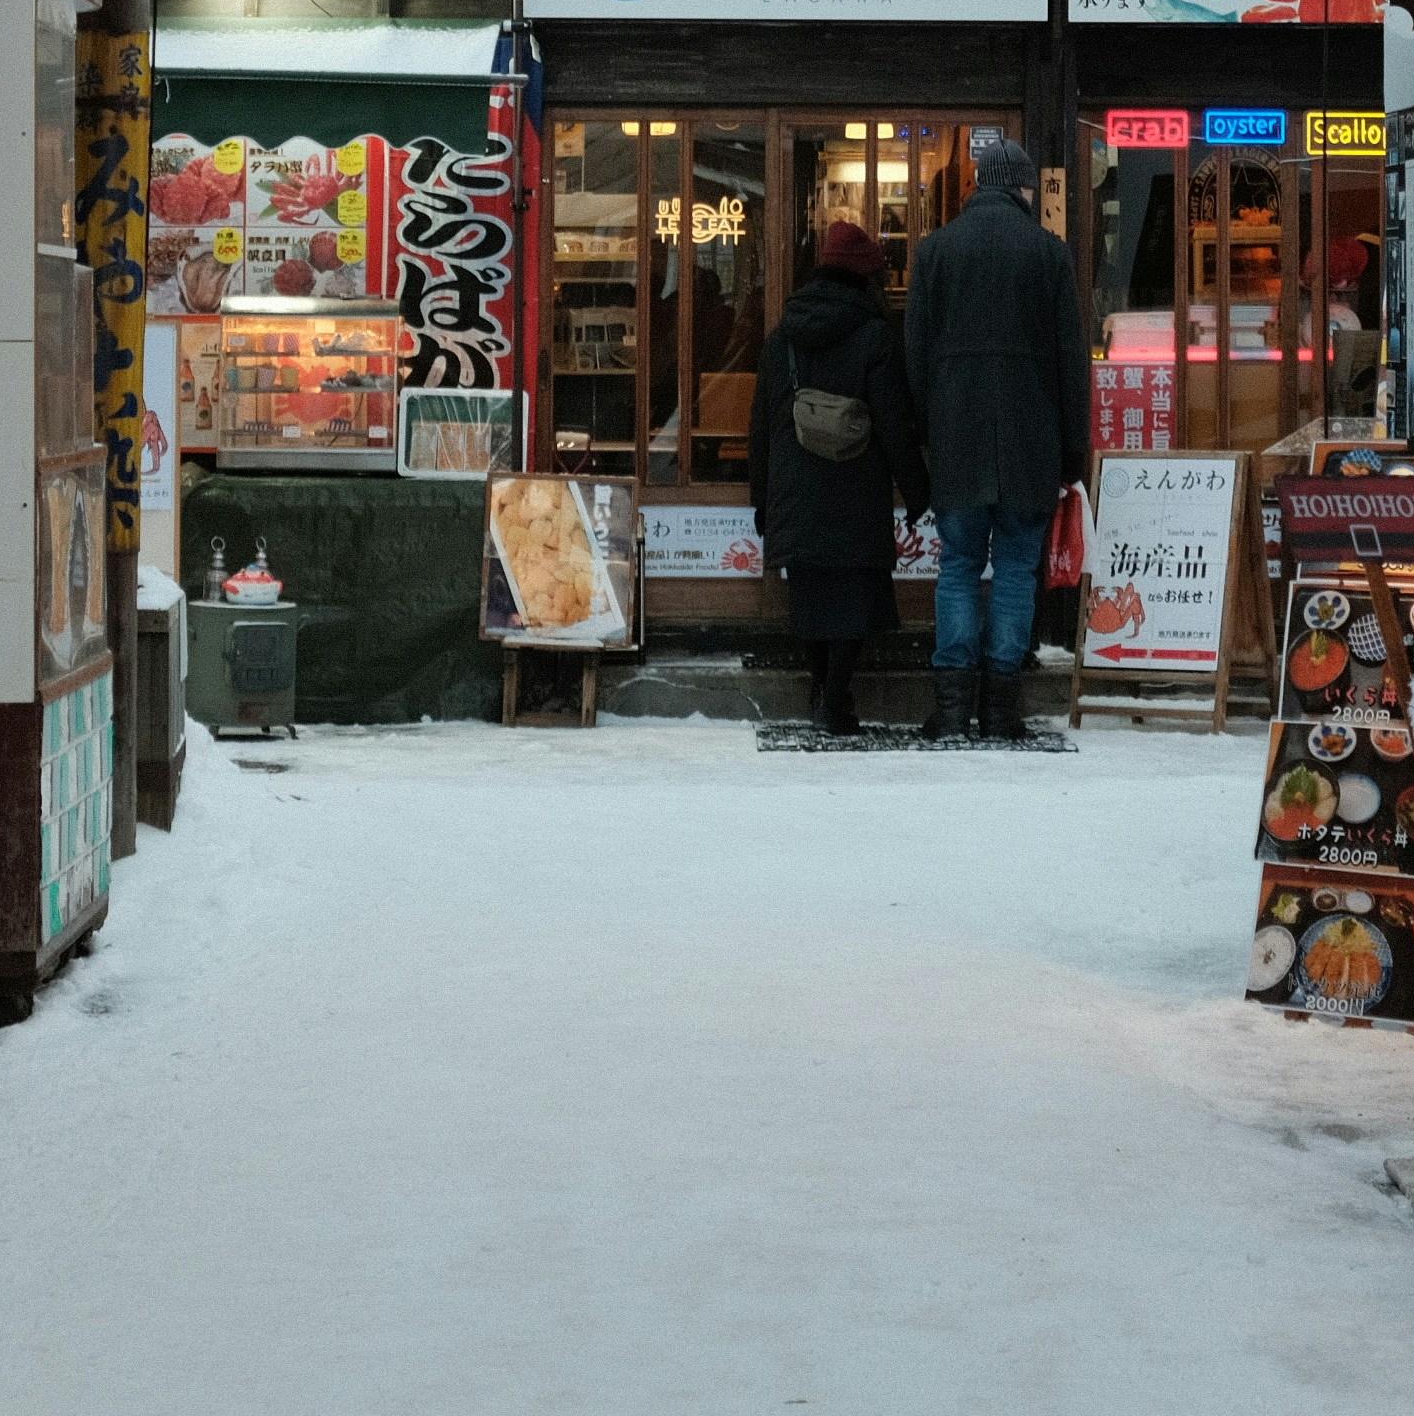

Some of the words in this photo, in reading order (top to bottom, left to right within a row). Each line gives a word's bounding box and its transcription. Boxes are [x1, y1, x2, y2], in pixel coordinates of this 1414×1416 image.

[1112, 119, 1183, 144] crab
[1213, 116, 1278, 140] oyster
[1313, 119, 1386, 146] Scallo
[1134, 469, 1226, 491] えんがわ
[1109, 542, 1208, 579] 海産品
[1331, 705, 1391, 725] 2800円
[1318, 844, 1379, 868] 2800円
[1304, 993, 1366, 1019] 2000円
